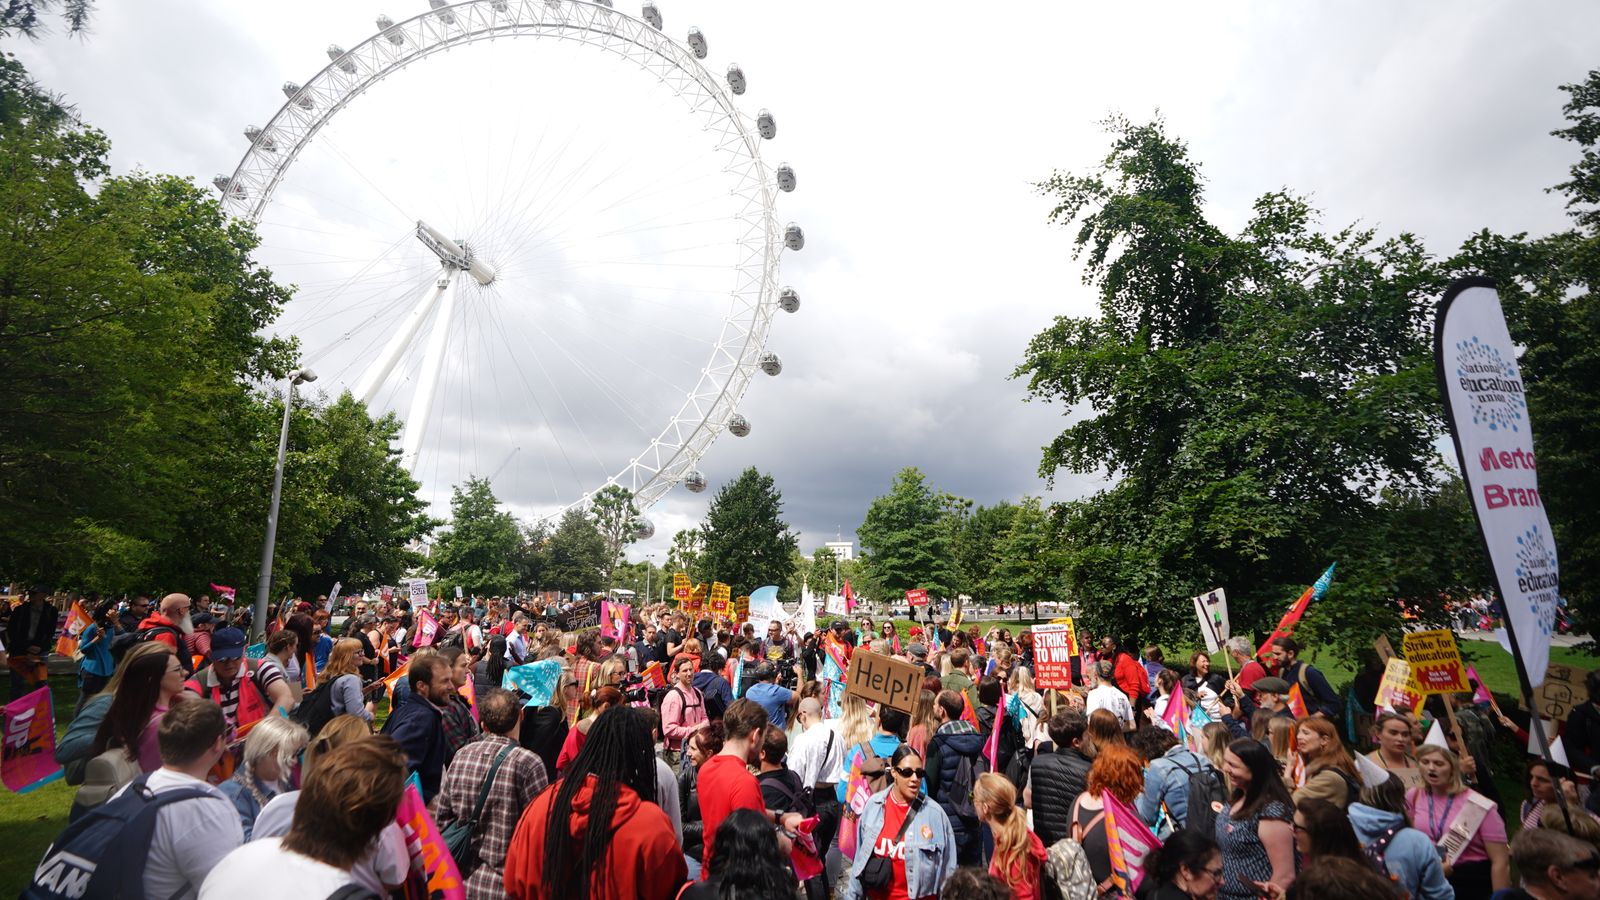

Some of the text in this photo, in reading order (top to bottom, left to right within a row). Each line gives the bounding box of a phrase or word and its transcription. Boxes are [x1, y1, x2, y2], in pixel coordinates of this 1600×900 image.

[1034, 632, 1067, 647] STRIKE
[1404, 638, 1452, 652] Strike for
[1035, 647, 1068, 662] TO WIN
[1408, 649, 1457, 664] education
[855, 657, 913, 705] Help!
[5, 707, 36, 751] UP
